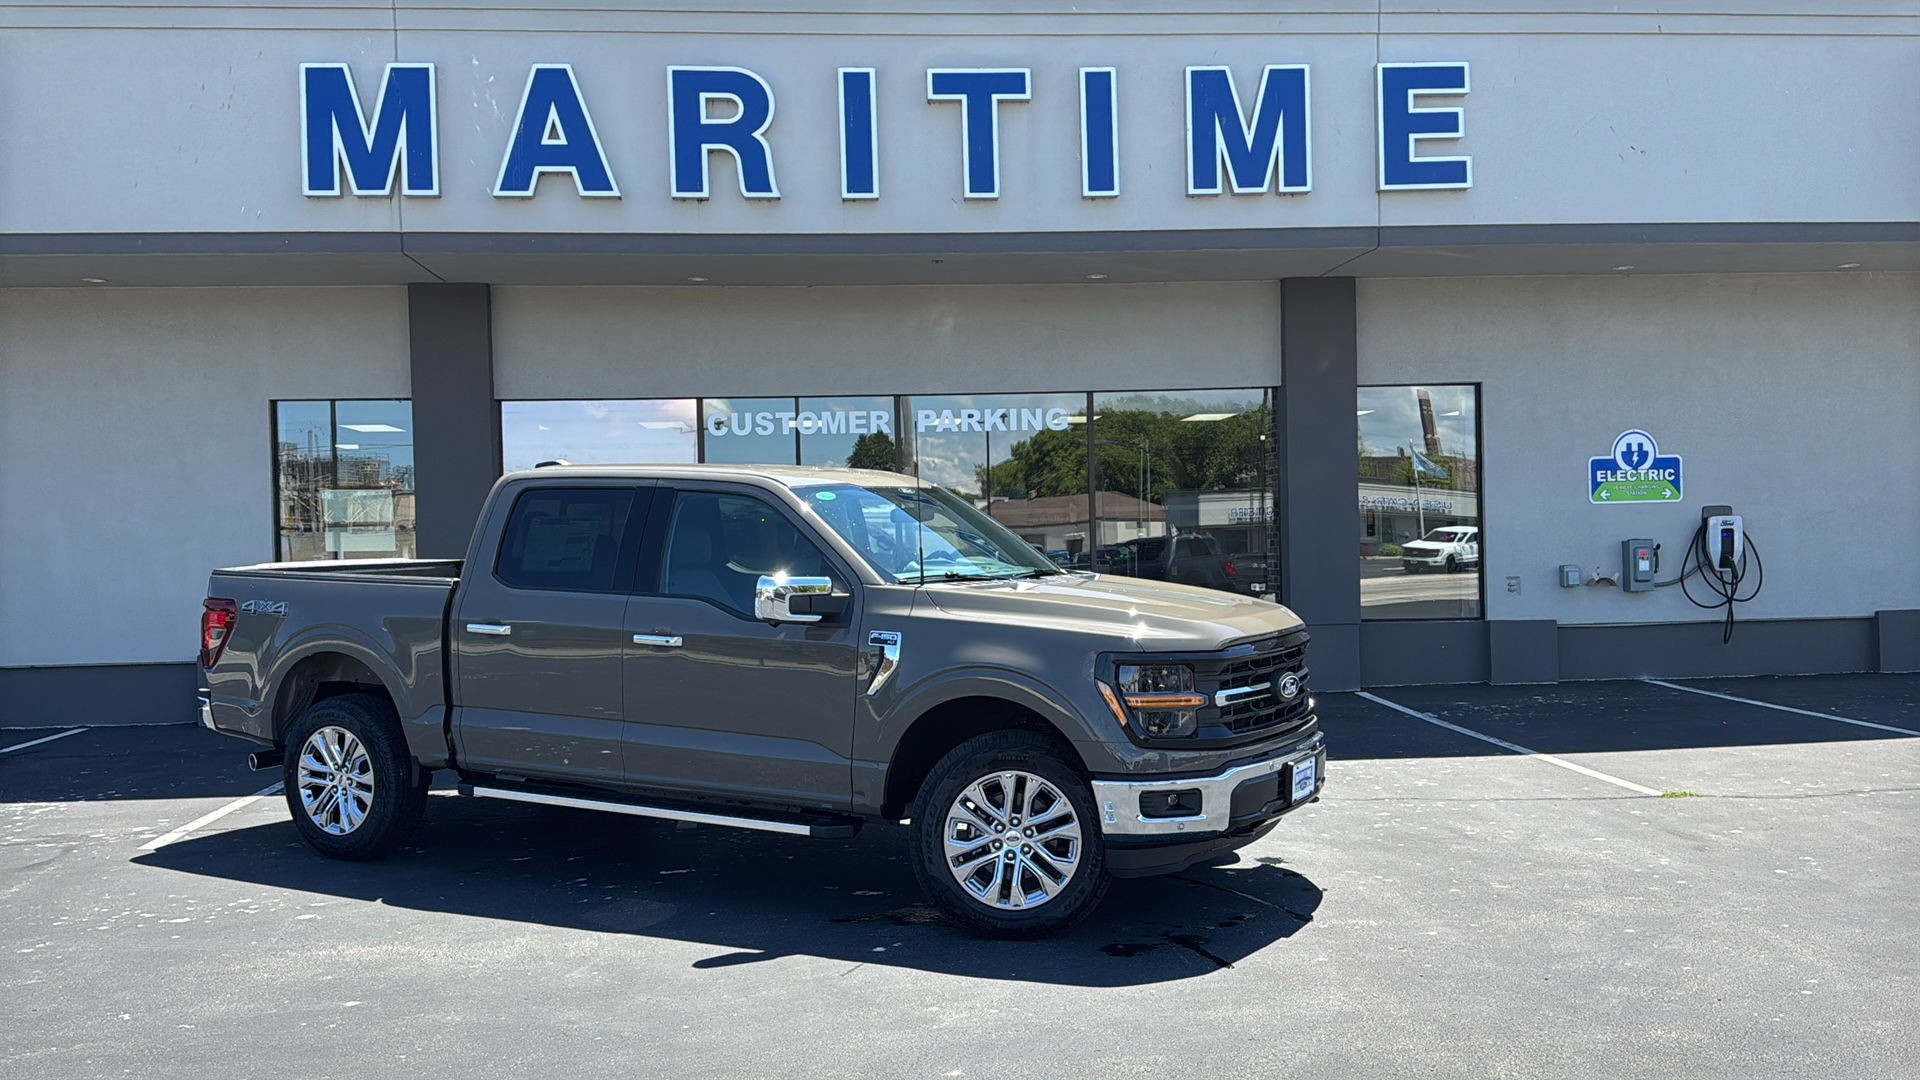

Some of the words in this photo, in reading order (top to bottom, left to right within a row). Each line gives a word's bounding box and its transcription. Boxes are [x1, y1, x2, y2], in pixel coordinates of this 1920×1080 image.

[299, 62, 1473, 200] MARITIME
[707, 410, 890, 437] CUSTOMER
[917, 407, 1069, 433] PARKING
[1596, 469, 1675, 482] ELECTRIC
